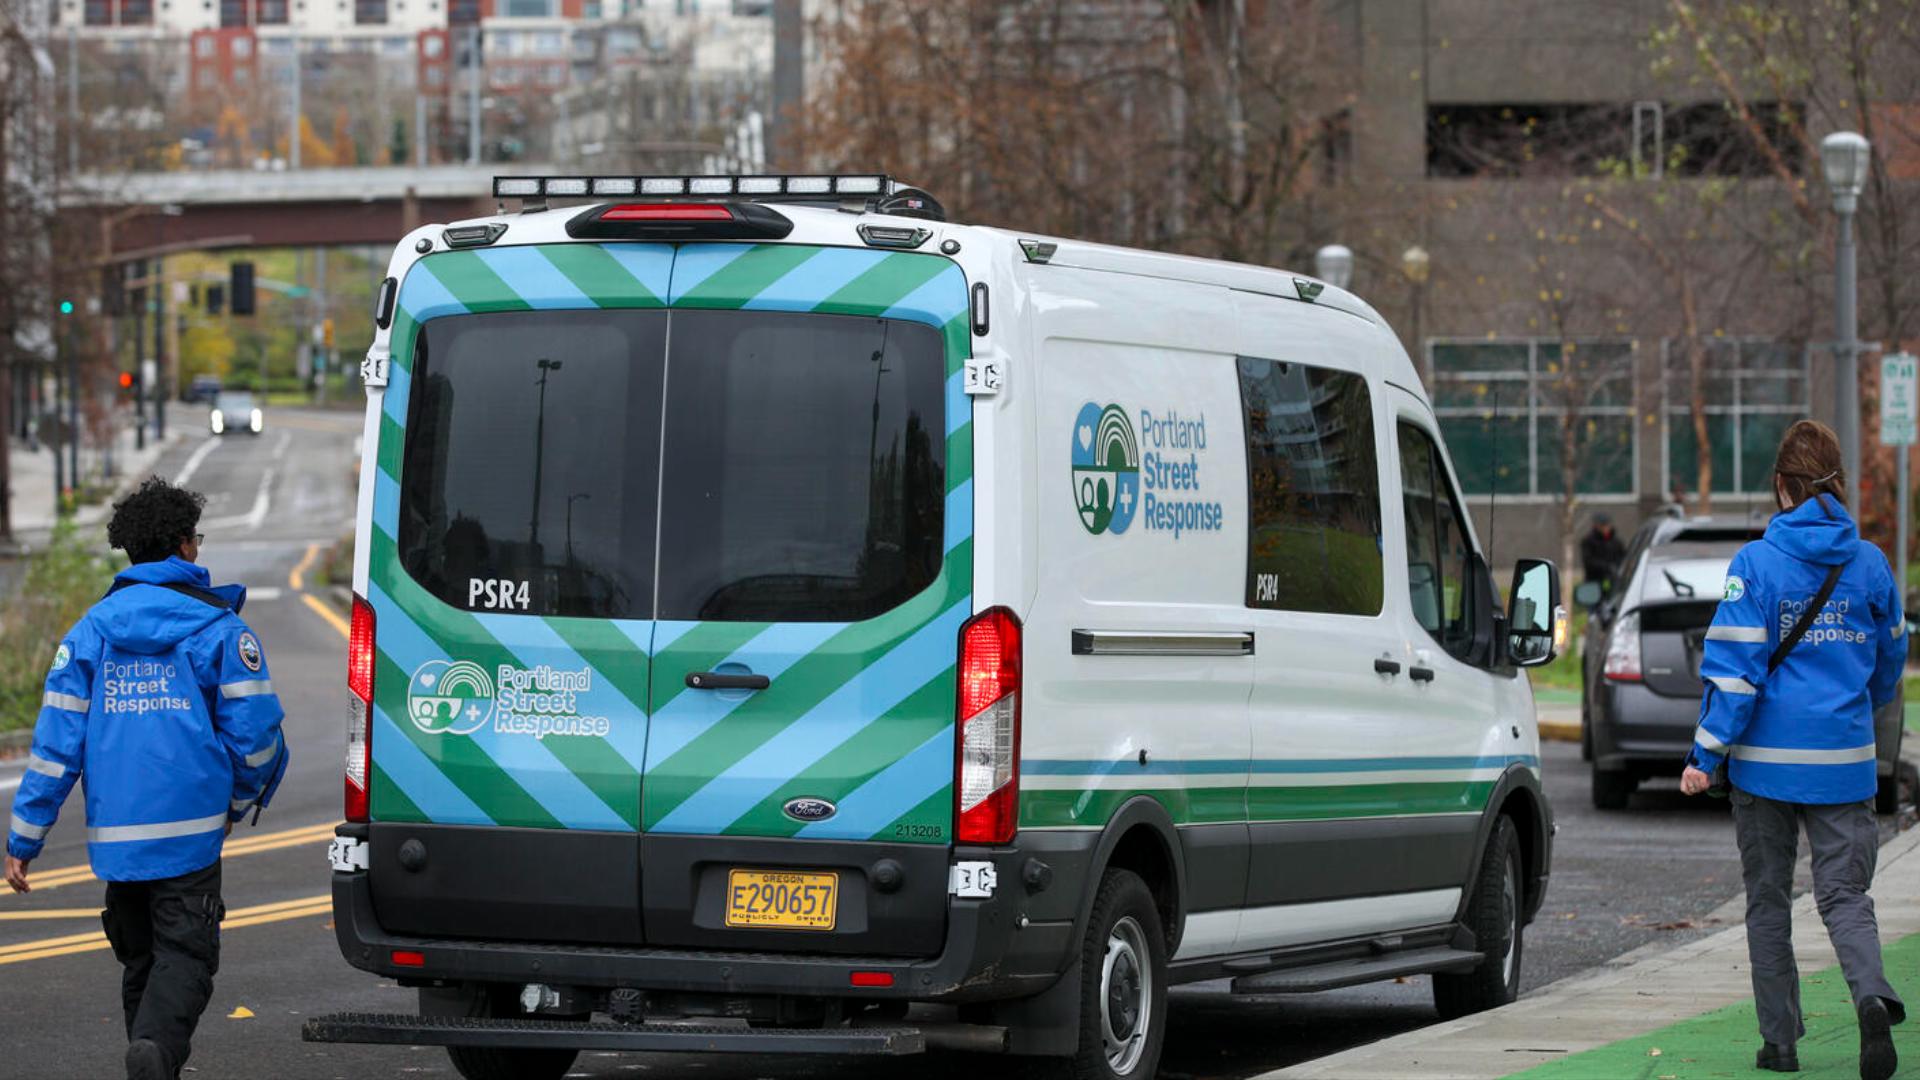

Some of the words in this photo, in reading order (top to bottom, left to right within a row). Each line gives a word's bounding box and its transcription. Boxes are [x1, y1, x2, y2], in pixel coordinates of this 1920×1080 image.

[1141, 409, 1206, 449] Portland
[1144, 452, 1198, 490] Street
[1144, 492, 1222, 540] Response
[469, 578, 530, 610] PSR4
[1256, 573, 1279, 601] PSR4
[1779, 628, 1866, 646] Rsponse
[104, 677, 169, 696] Street
[498, 664, 591, 691] Portland
[104, 696, 192, 715] Response
[498, 687, 576, 713] Street
[495, 710, 609, 739] Response
[794, 801, 824, 816] Ford
[895, 824, 942, 838] 213208
[762, 874, 804, 884] OREGON
[733, 883, 831, 915] E290657
